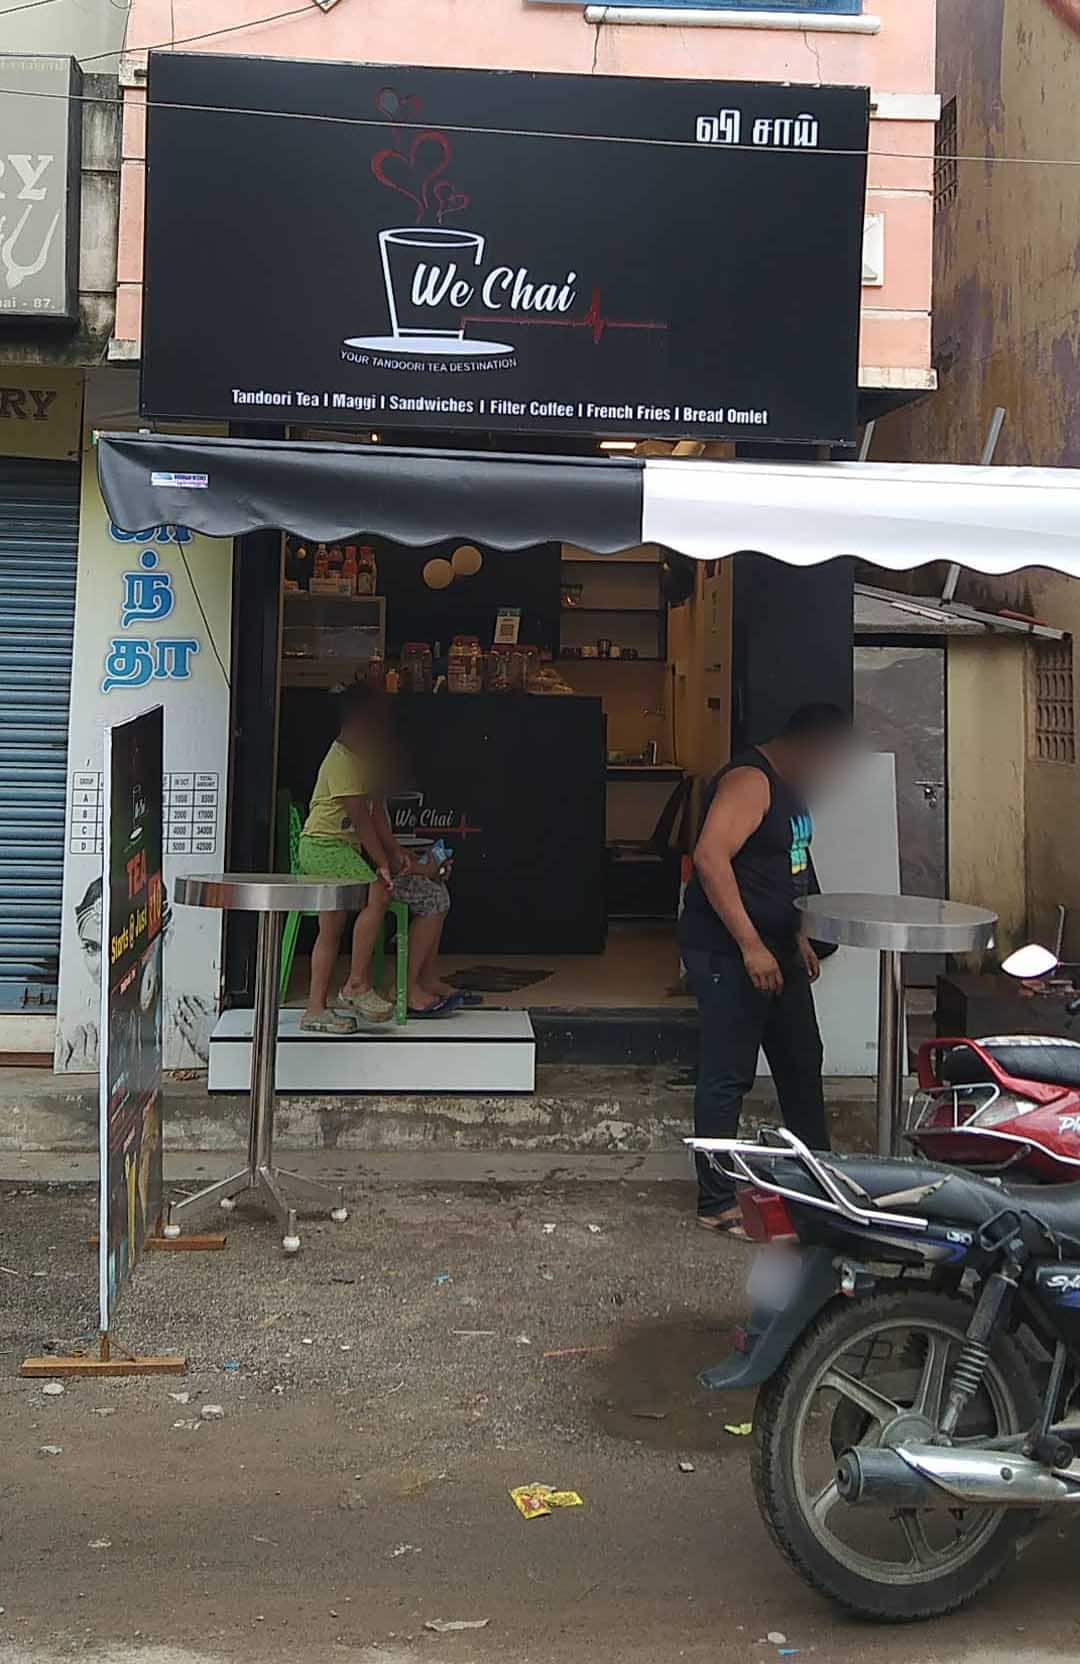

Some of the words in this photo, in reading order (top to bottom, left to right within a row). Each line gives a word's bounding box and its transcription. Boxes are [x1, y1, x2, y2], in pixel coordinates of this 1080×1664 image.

[752, 113, 818, 147] சாய்
[0, 155, 54, 200] Y
[411, 263, 475, 307] We
[482, 266, 577, 312] Chai
[340, 350, 369, 365] YOUR
[372, 357, 425, 371] TANDOORI
[428, 363, 448, 372] TEA
[450, 358, 517, 372] DESTINATION
[231, 389, 292, 405] Tandoori
[295, 391, 319, 407] Tea
[332, 393, 377, 411] Maggi
[389, 395, 474, 413] Sandwiches
[490, 399, 527, 415] Filter
[529, 401, 574, 417] Coffee
[586, 403, 633, 420] French
[636, 405, 671, 421] Fries
[683, 406, 724, 423] Bread
[727, 408, 768, 425] Omlet
[83, 793, 89, 803] A
[80, 841, 86, 851] D
[82, 825, 88, 835] C
[127, 849, 148, 899] TEA
